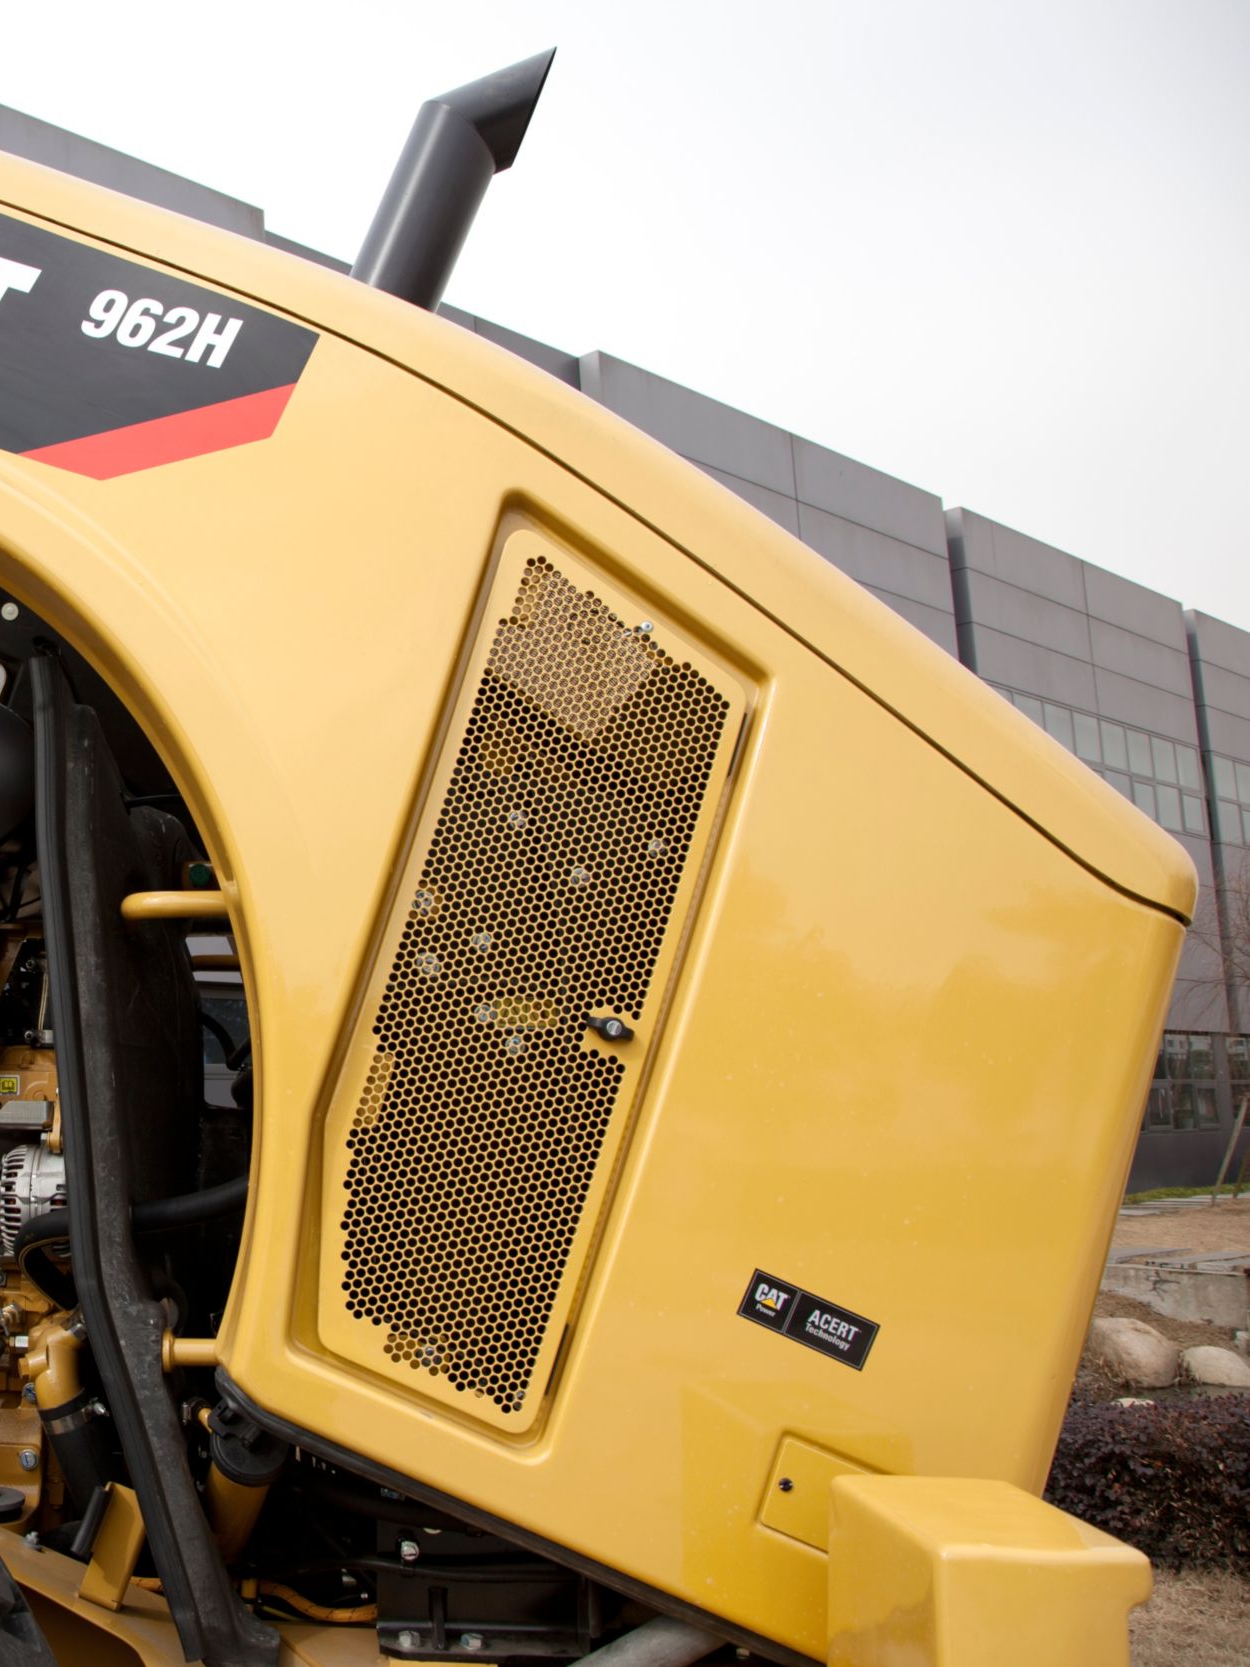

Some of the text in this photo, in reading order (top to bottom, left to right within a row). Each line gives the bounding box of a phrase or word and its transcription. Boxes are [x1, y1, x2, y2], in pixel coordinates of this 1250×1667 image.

[81, 289, 244, 369] 962H
[754, 1283, 788, 1311] CAT
[755, 1303, 776, 1318] Power
[805, 1322, 851, 1351] Technology
[807, 1309, 860, 1341] ACERT
